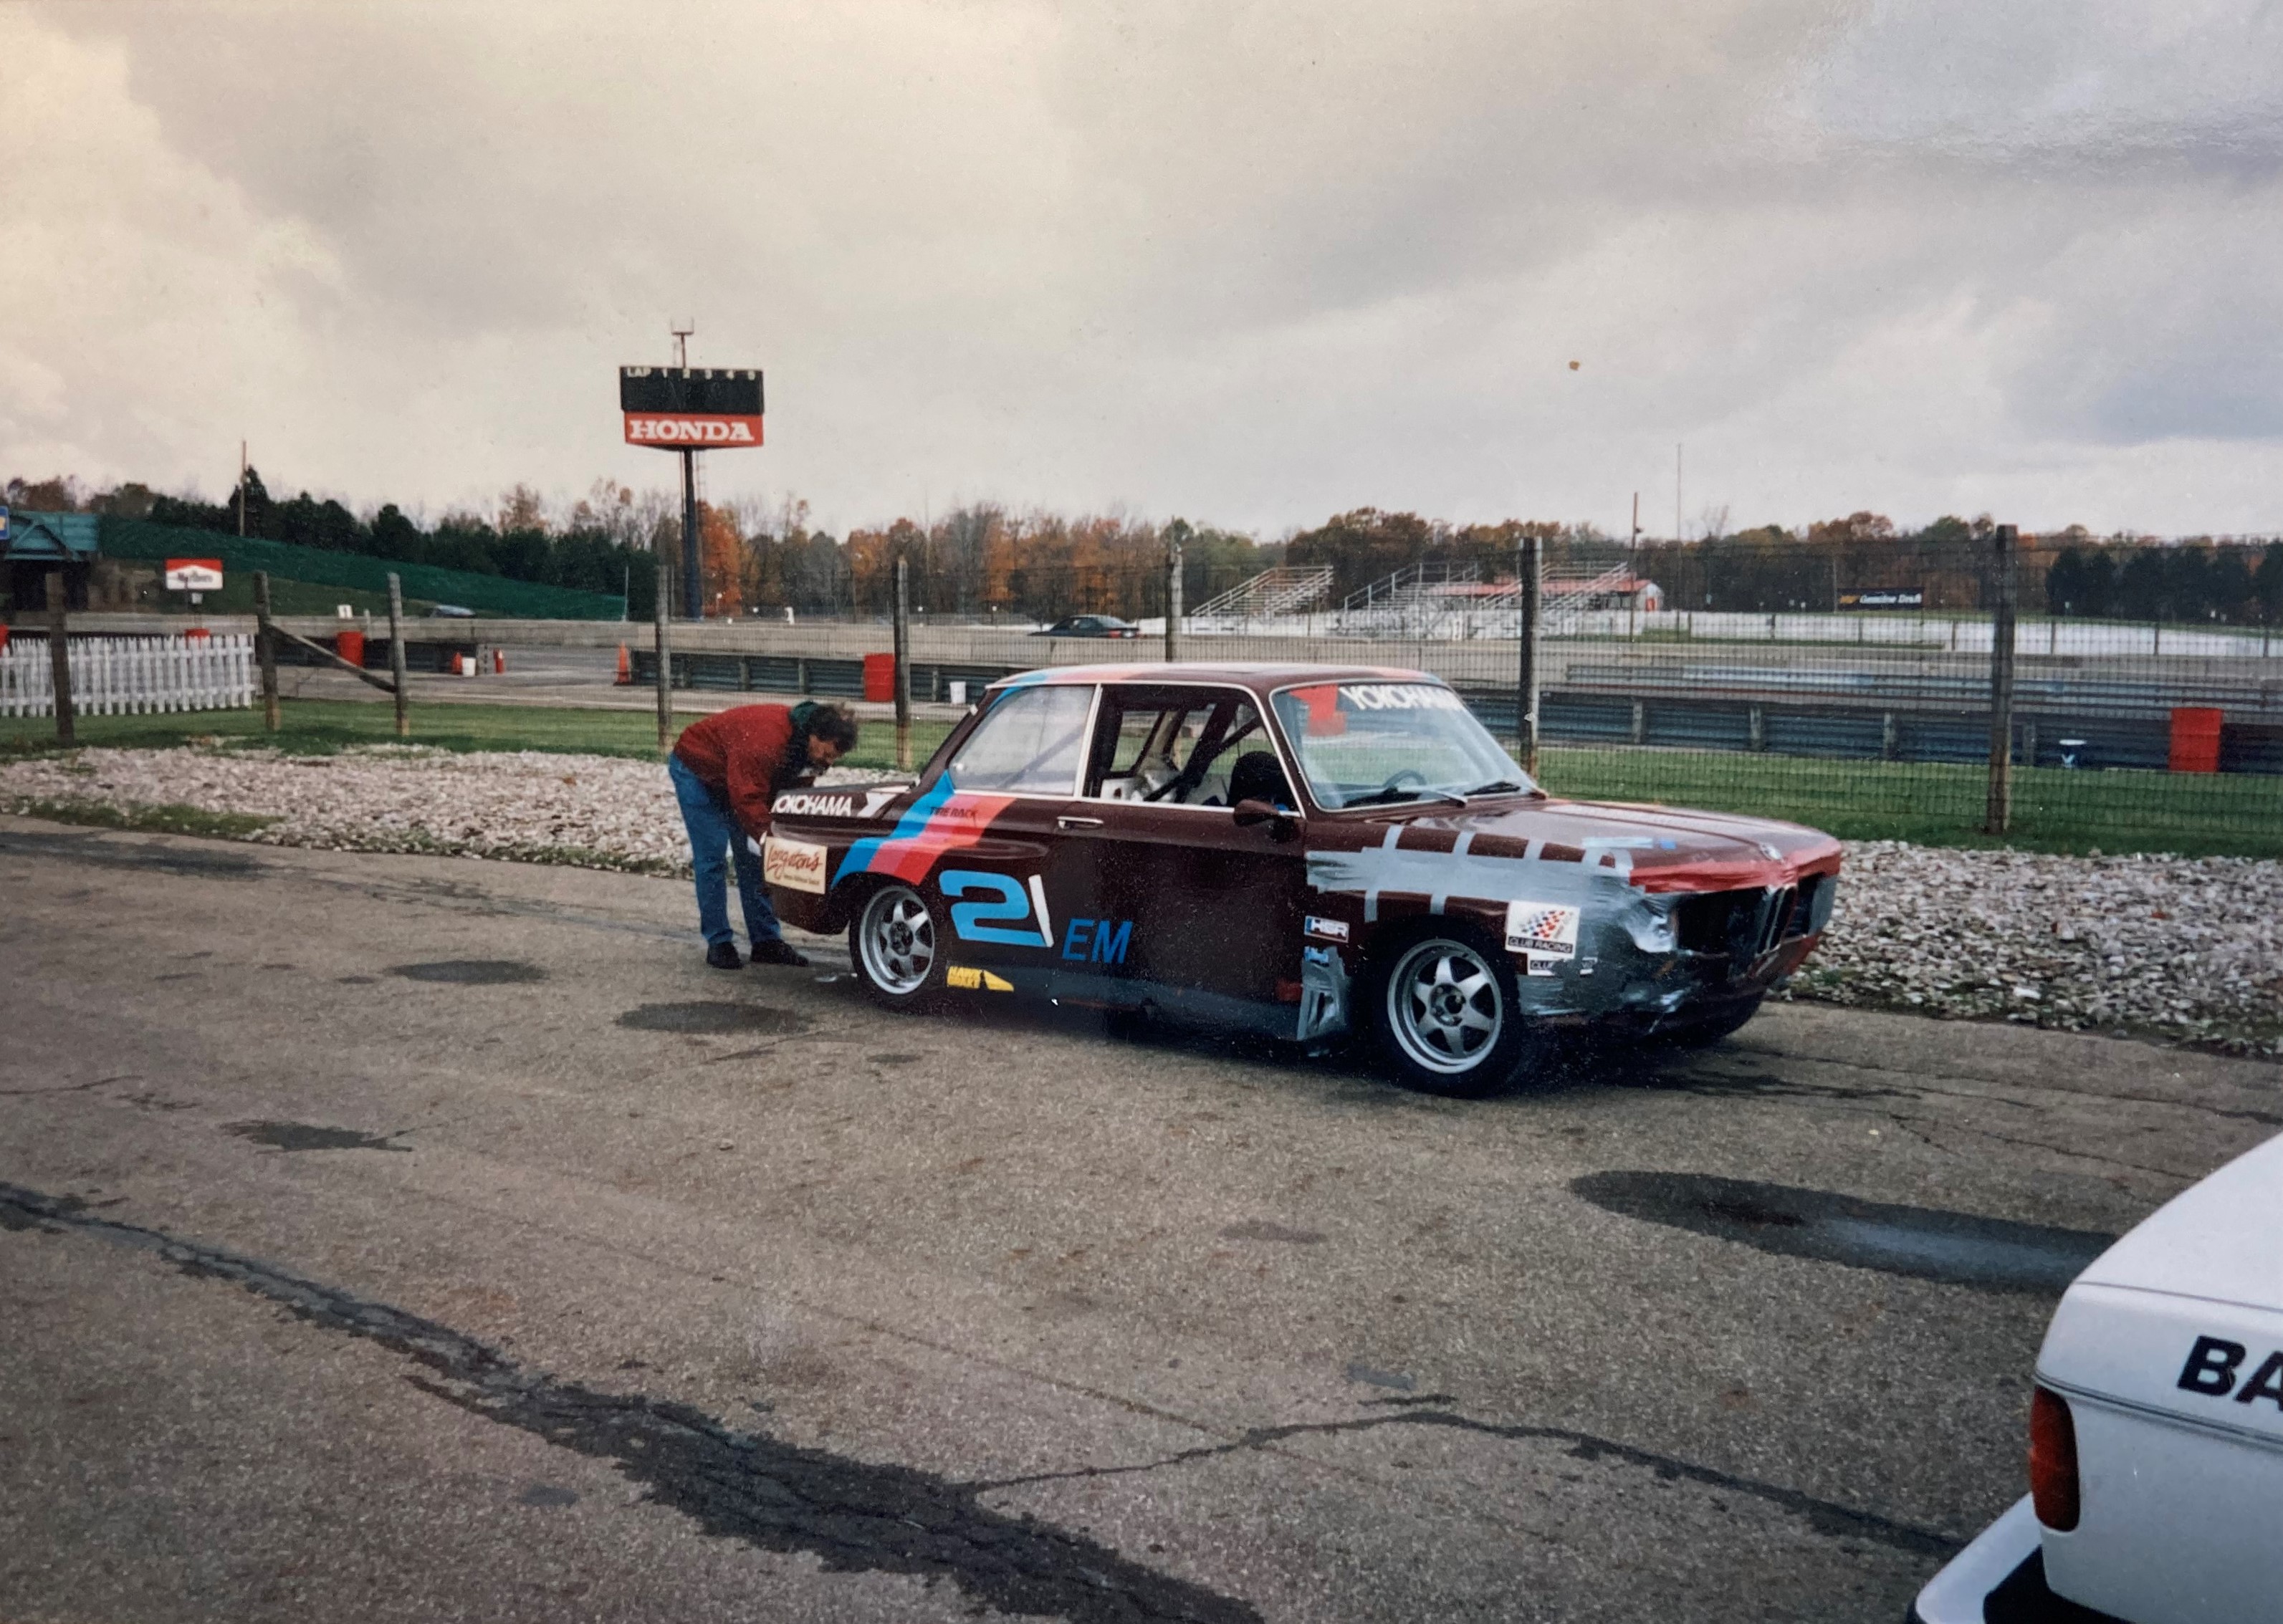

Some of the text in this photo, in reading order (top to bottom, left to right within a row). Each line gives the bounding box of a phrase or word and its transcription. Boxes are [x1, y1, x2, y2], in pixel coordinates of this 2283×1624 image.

[626, 367, 652, 378] LAP
[682, 368, 691, 379] 2
[629, 419, 755, 442] HONDA
[1062, 918, 1134, 964] EM
[1508, 936, 1573, 953] CLUB RACING
